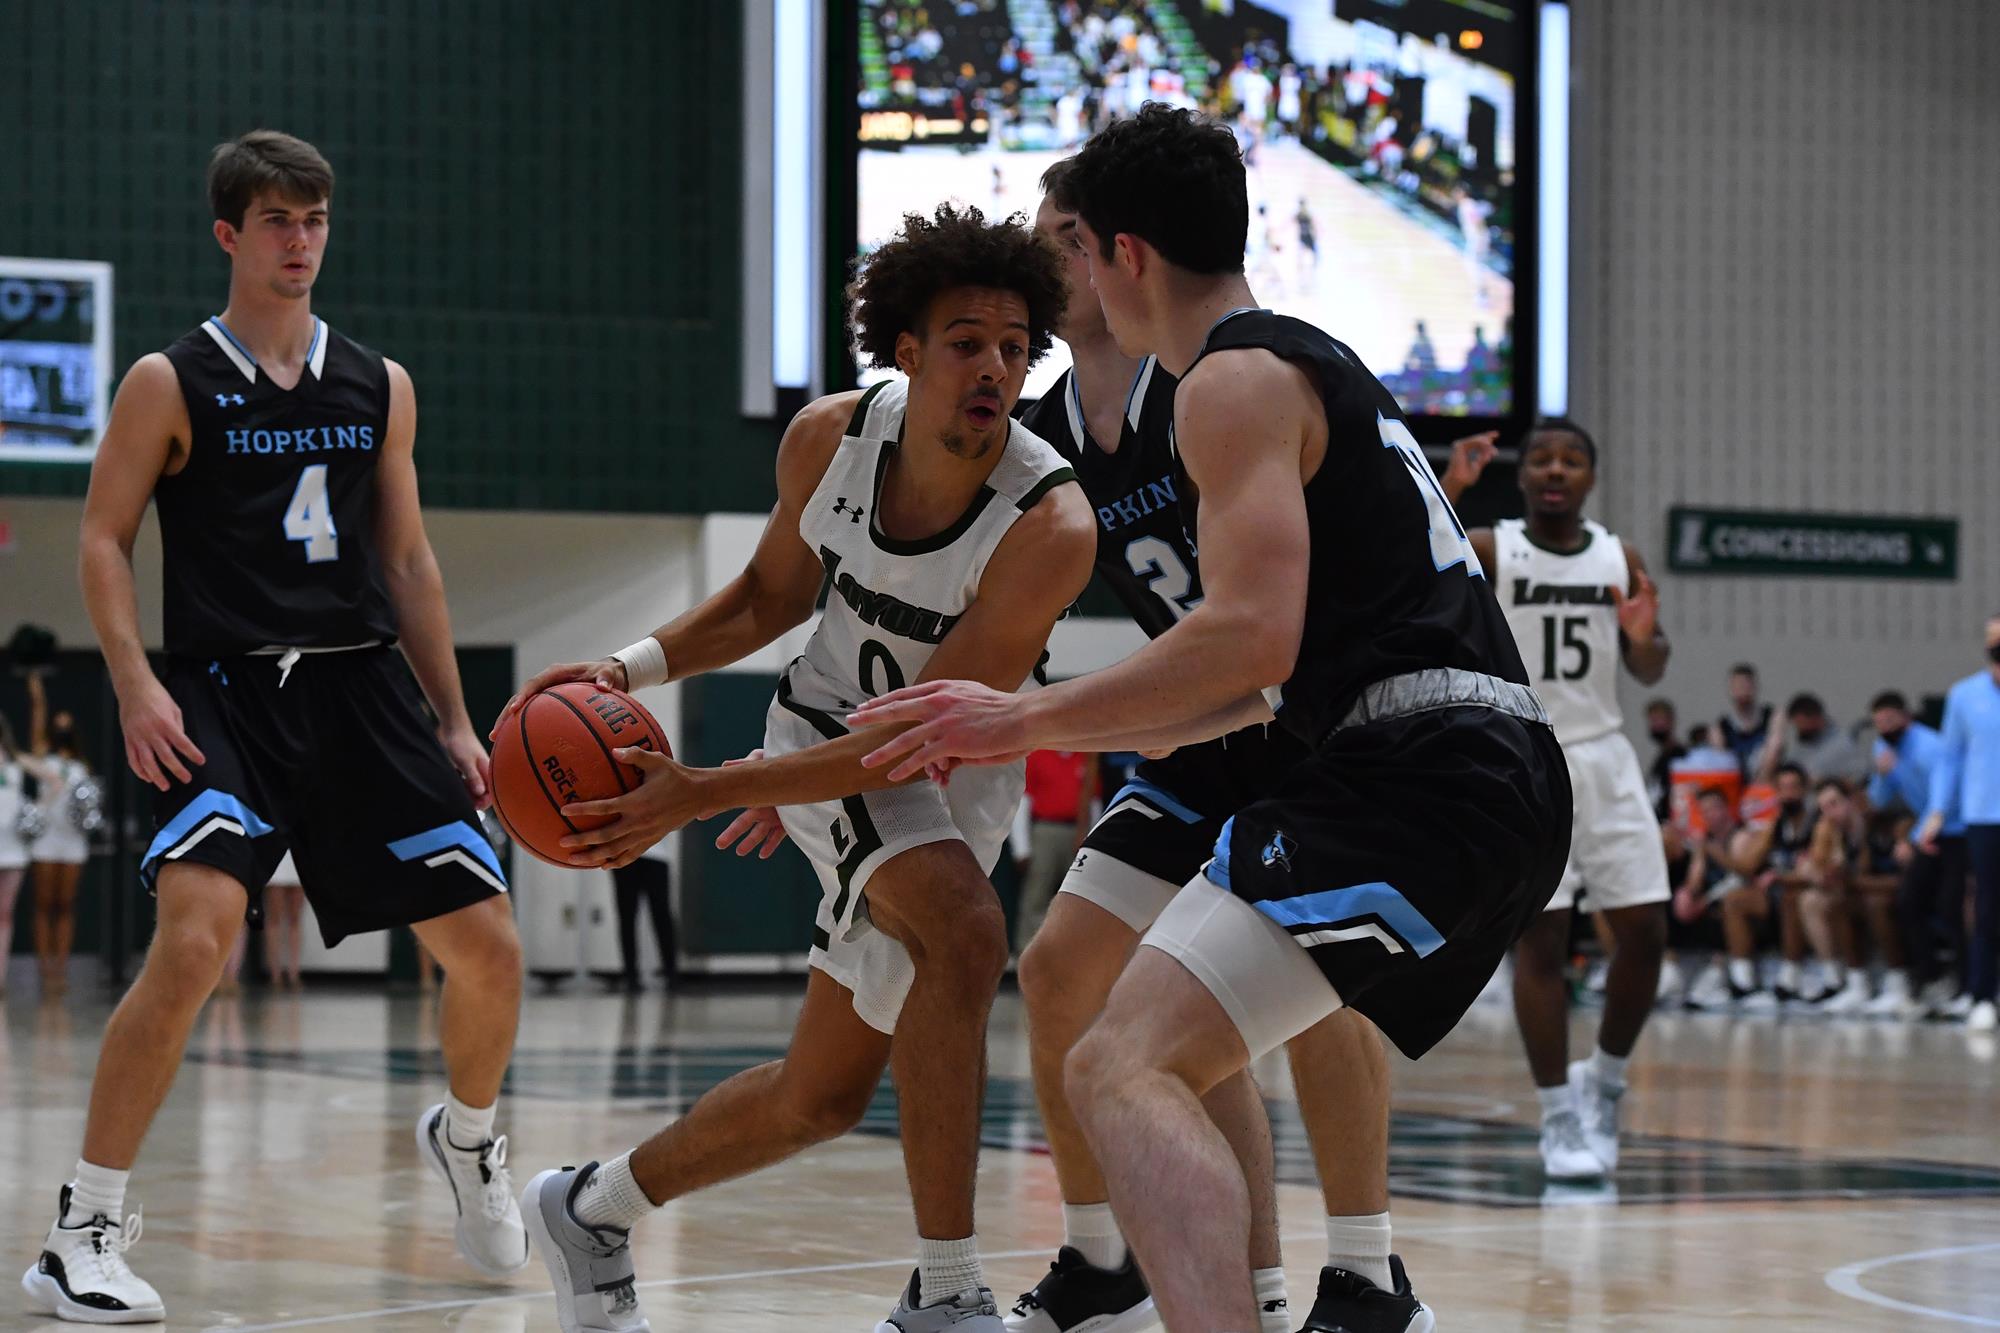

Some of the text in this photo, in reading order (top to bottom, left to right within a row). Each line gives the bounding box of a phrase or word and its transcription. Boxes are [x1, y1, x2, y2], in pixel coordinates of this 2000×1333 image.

[225, 426, 374, 454] HOPKINS
[283, 464, 339, 564] 4
[1098, 475, 1178, 532] PKIN
[1714, 527, 1911, 564] CONCESSIONS
[859, 638, 906, 697] 0
[1541, 615, 1591, 682] 15
[586, 692, 638, 735] THE
[543, 755, 580, 804] ROCK
